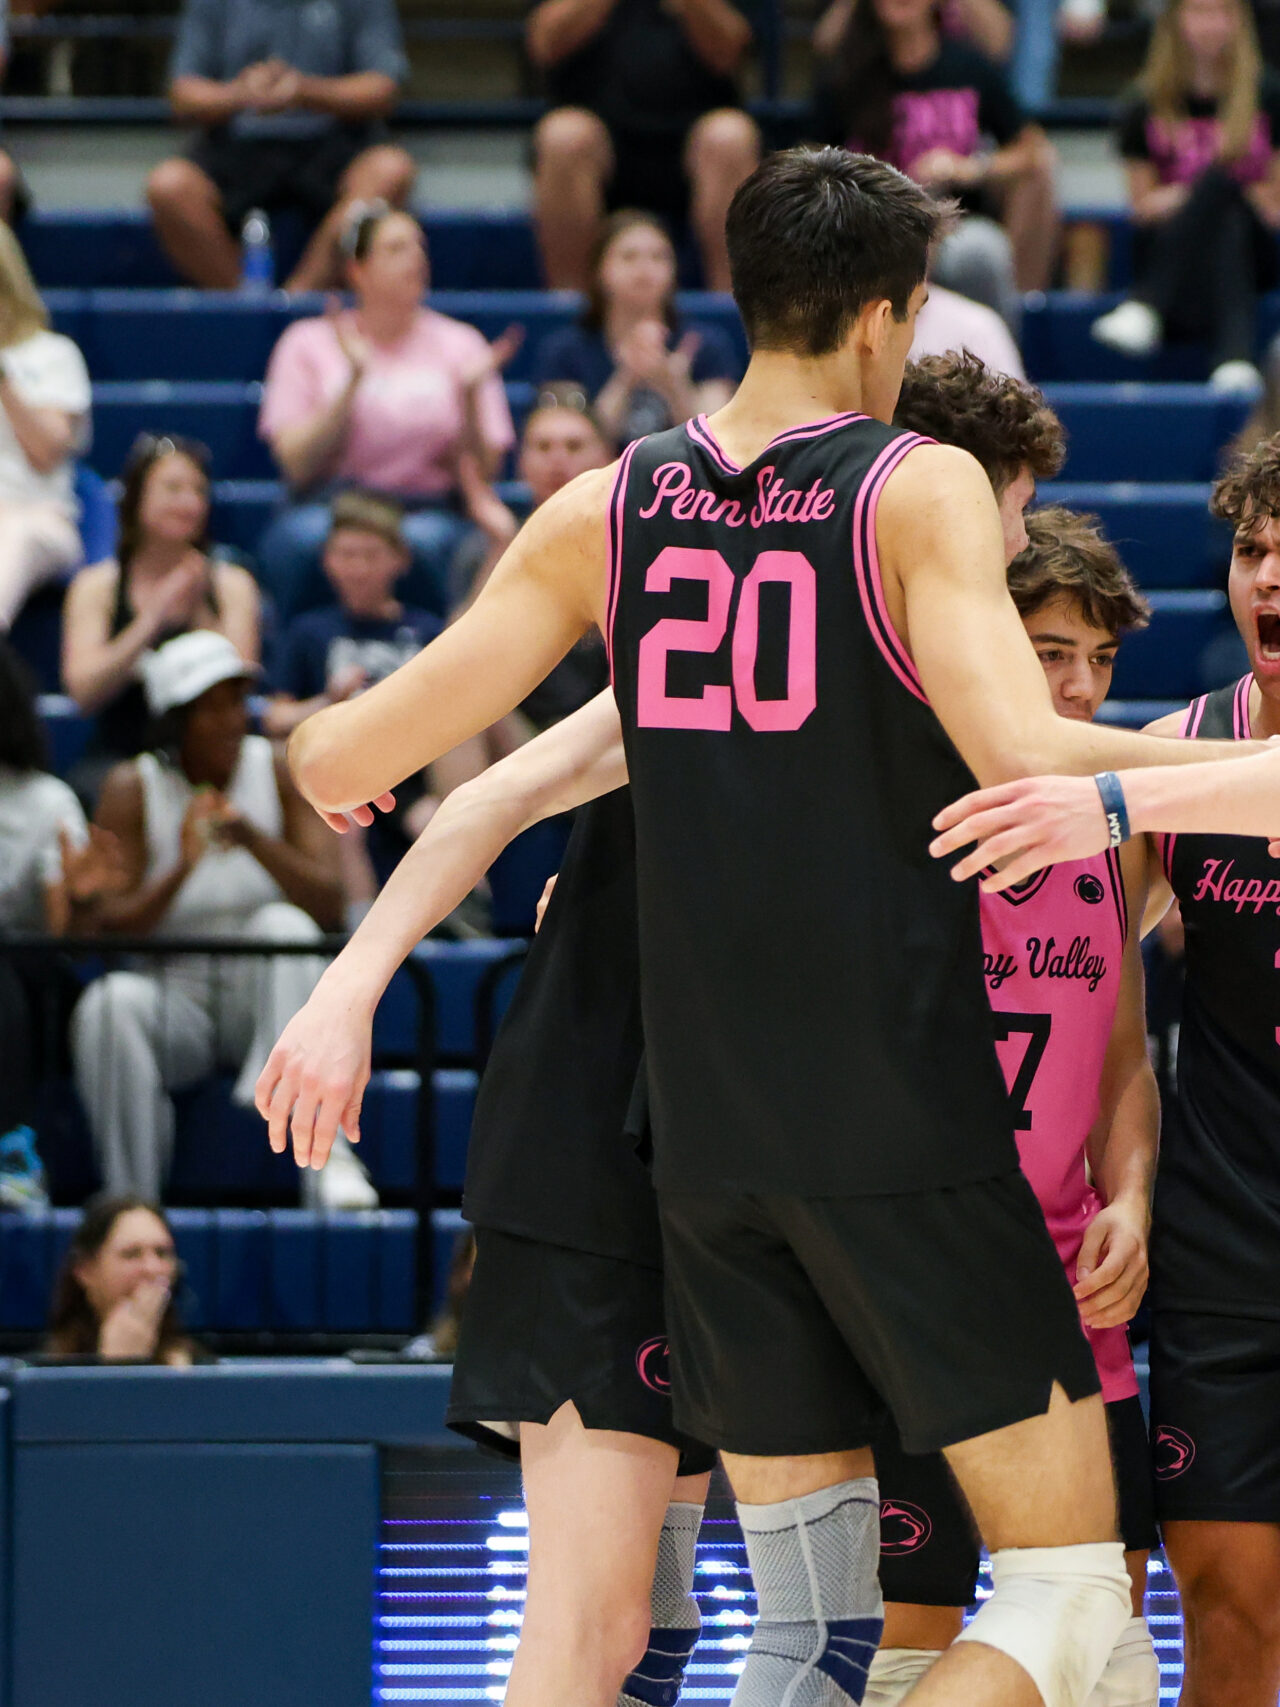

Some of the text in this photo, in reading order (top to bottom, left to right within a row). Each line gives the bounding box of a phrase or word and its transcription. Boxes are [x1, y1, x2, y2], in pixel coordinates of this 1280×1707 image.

[639, 461, 836, 529] Penn State
[637, 546, 817, 732] 20
[1026, 935, 1107, 993] Valley
